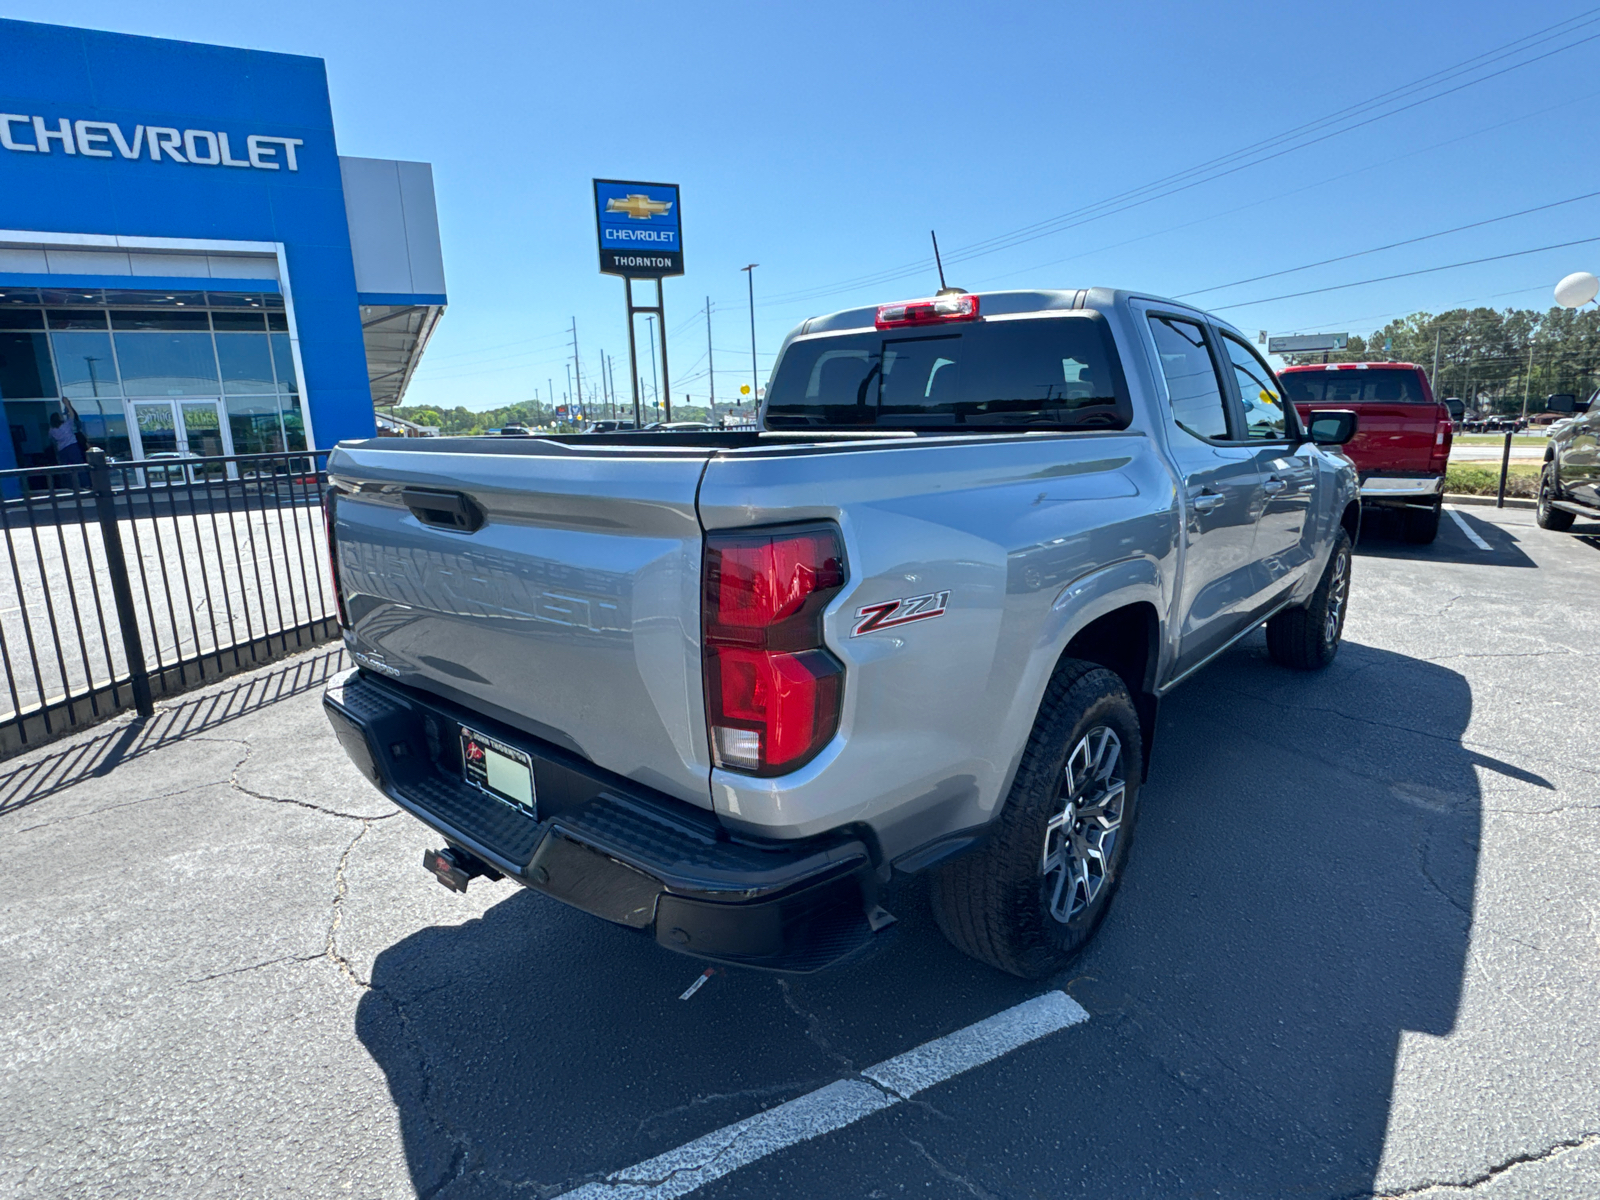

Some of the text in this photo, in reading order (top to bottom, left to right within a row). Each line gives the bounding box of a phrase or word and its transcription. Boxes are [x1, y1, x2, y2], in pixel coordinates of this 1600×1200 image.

[0, 113, 304, 172] CHEVROLET
[605, 228, 675, 242] CHEVROLET
[613, 256, 672, 267] THORNTON
[849, 589, 952, 639] Z71
